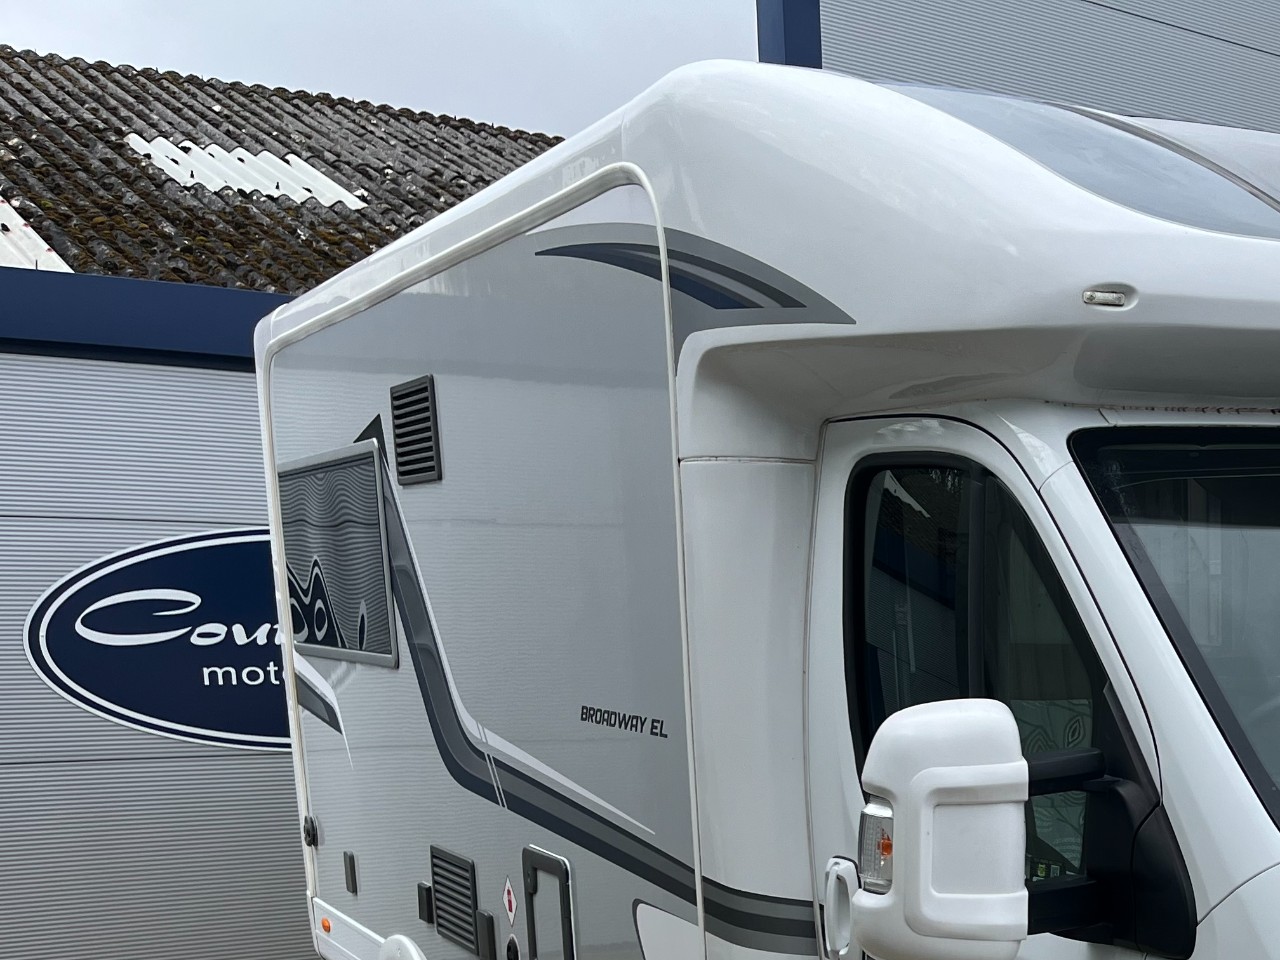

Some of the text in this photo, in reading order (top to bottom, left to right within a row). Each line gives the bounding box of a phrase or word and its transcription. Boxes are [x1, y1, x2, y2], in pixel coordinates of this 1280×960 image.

[75, 588, 281, 646] Cou
[203, 660, 284, 686] mot
[580, 705, 668, 738] BROADWAY EL
